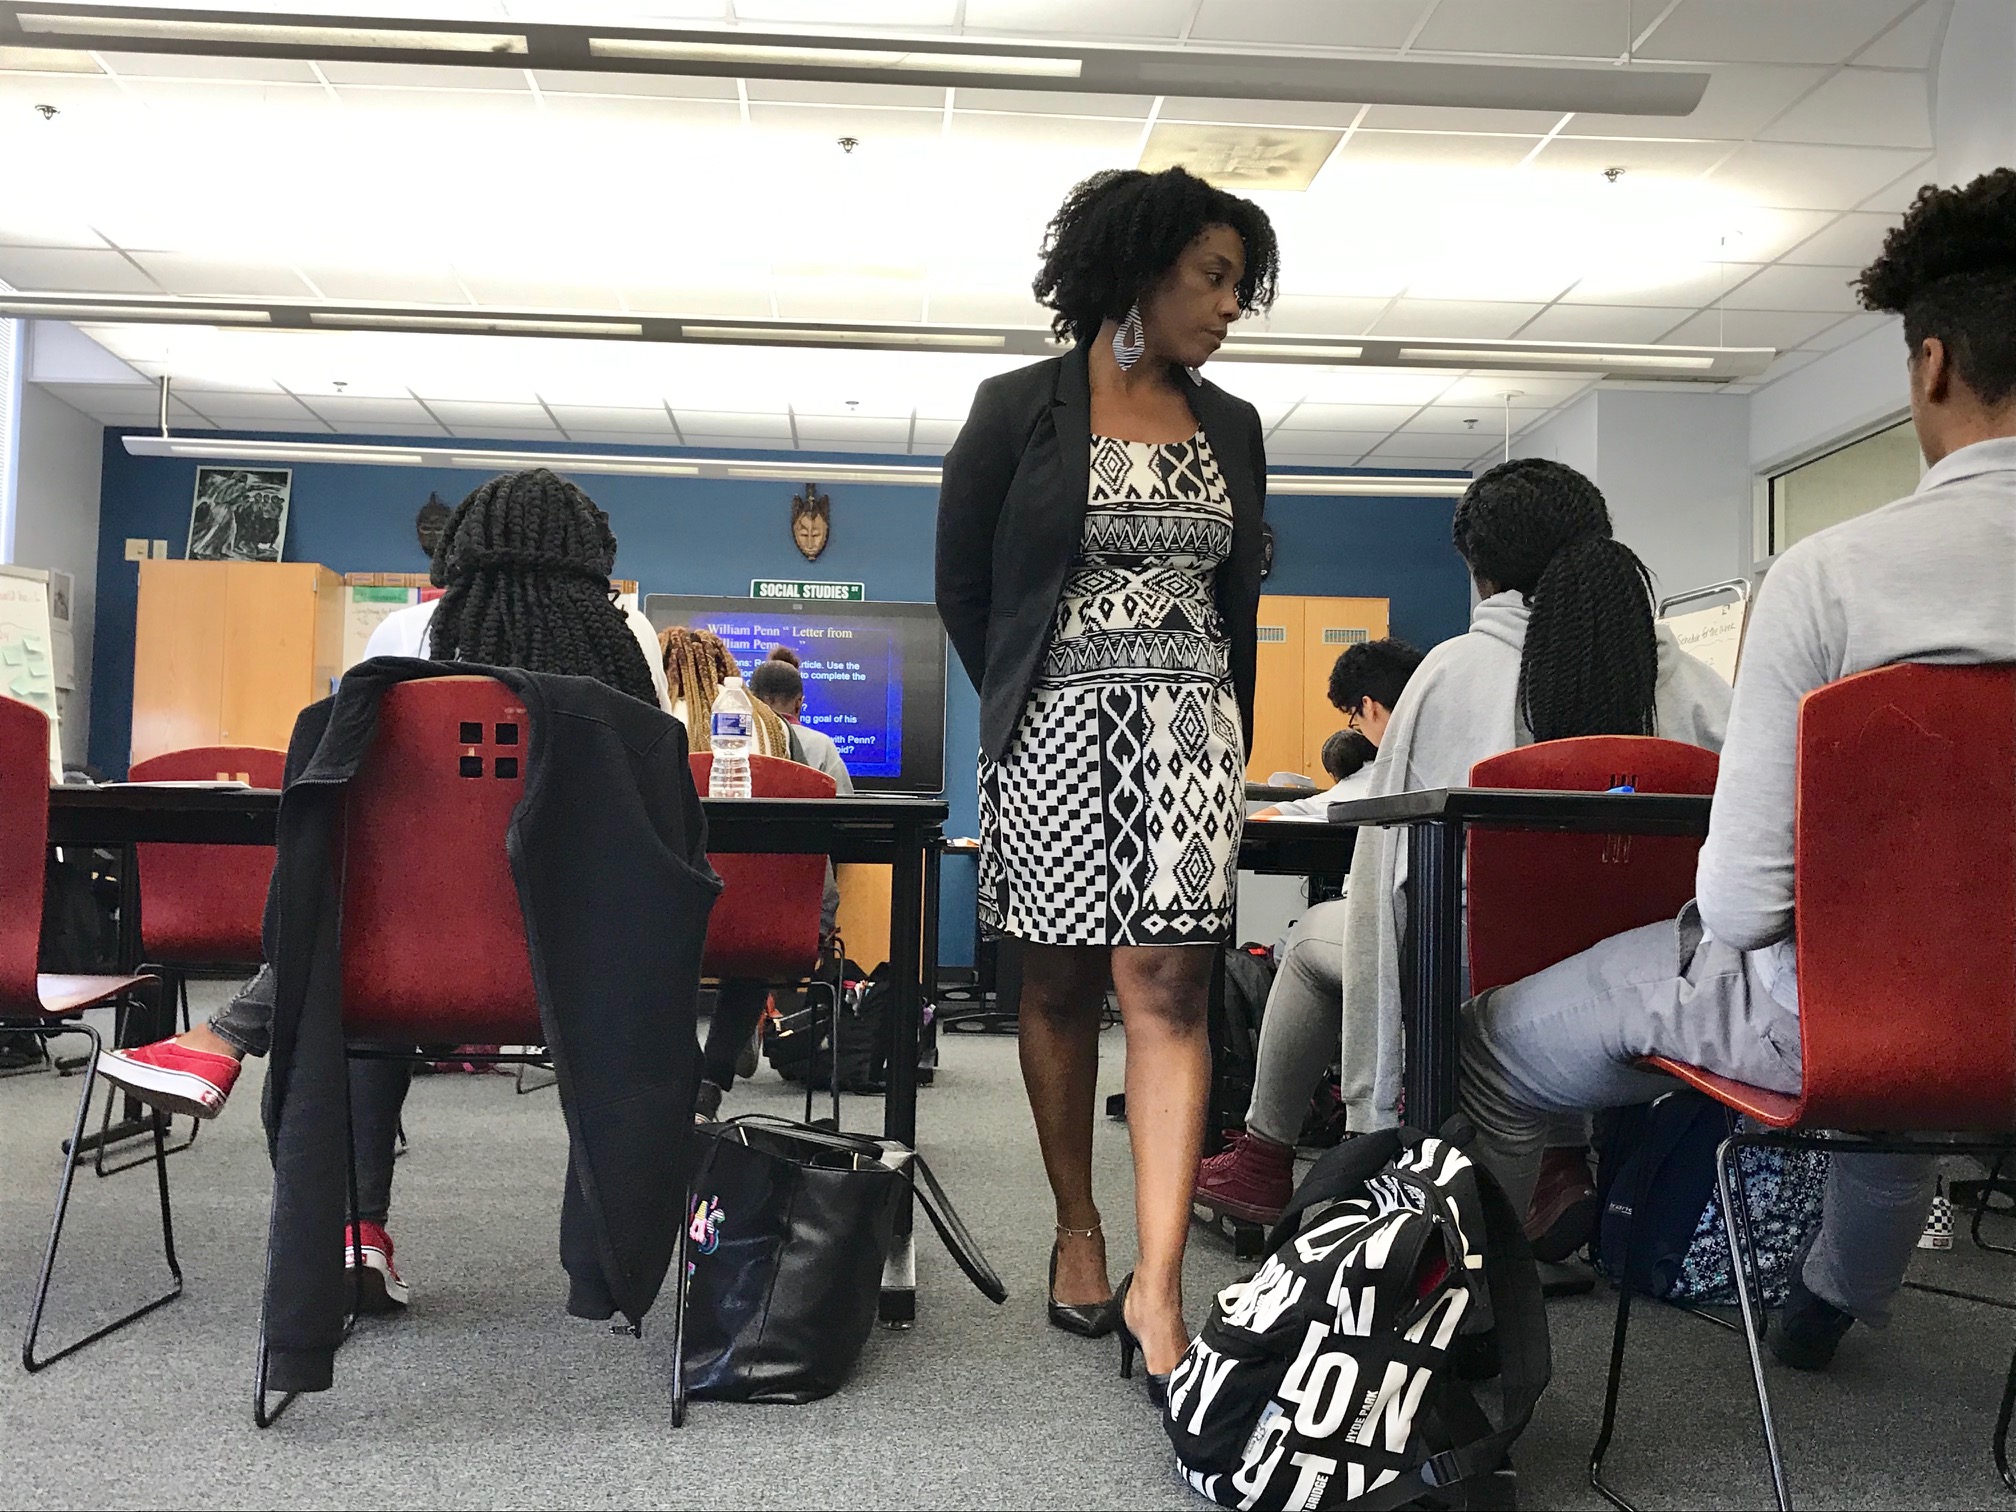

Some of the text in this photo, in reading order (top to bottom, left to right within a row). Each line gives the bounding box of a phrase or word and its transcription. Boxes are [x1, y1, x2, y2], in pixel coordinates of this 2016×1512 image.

[760, 583, 800, 597] SOCIAL
[803, 585, 849, 599] STUDIES
[707, 624, 750, 635] William
[753, 625, 780, 636] Penn
[792, 627, 824, 638] Letter
[827, 627, 853, 639] from
[826, 661, 844, 670] Use
[845, 661, 860, 670] the
[800, 671, 867, 682] to complete the
[813, 715, 832, 724] goal
[833, 715, 843, 723] of
[844, 715, 858, 724] his
[847, 735, 876, 744] Penn?
[1345, 1390, 1379, 1443] HYDE PARK
[1305, 1474, 1330, 1510] BRIDGE
